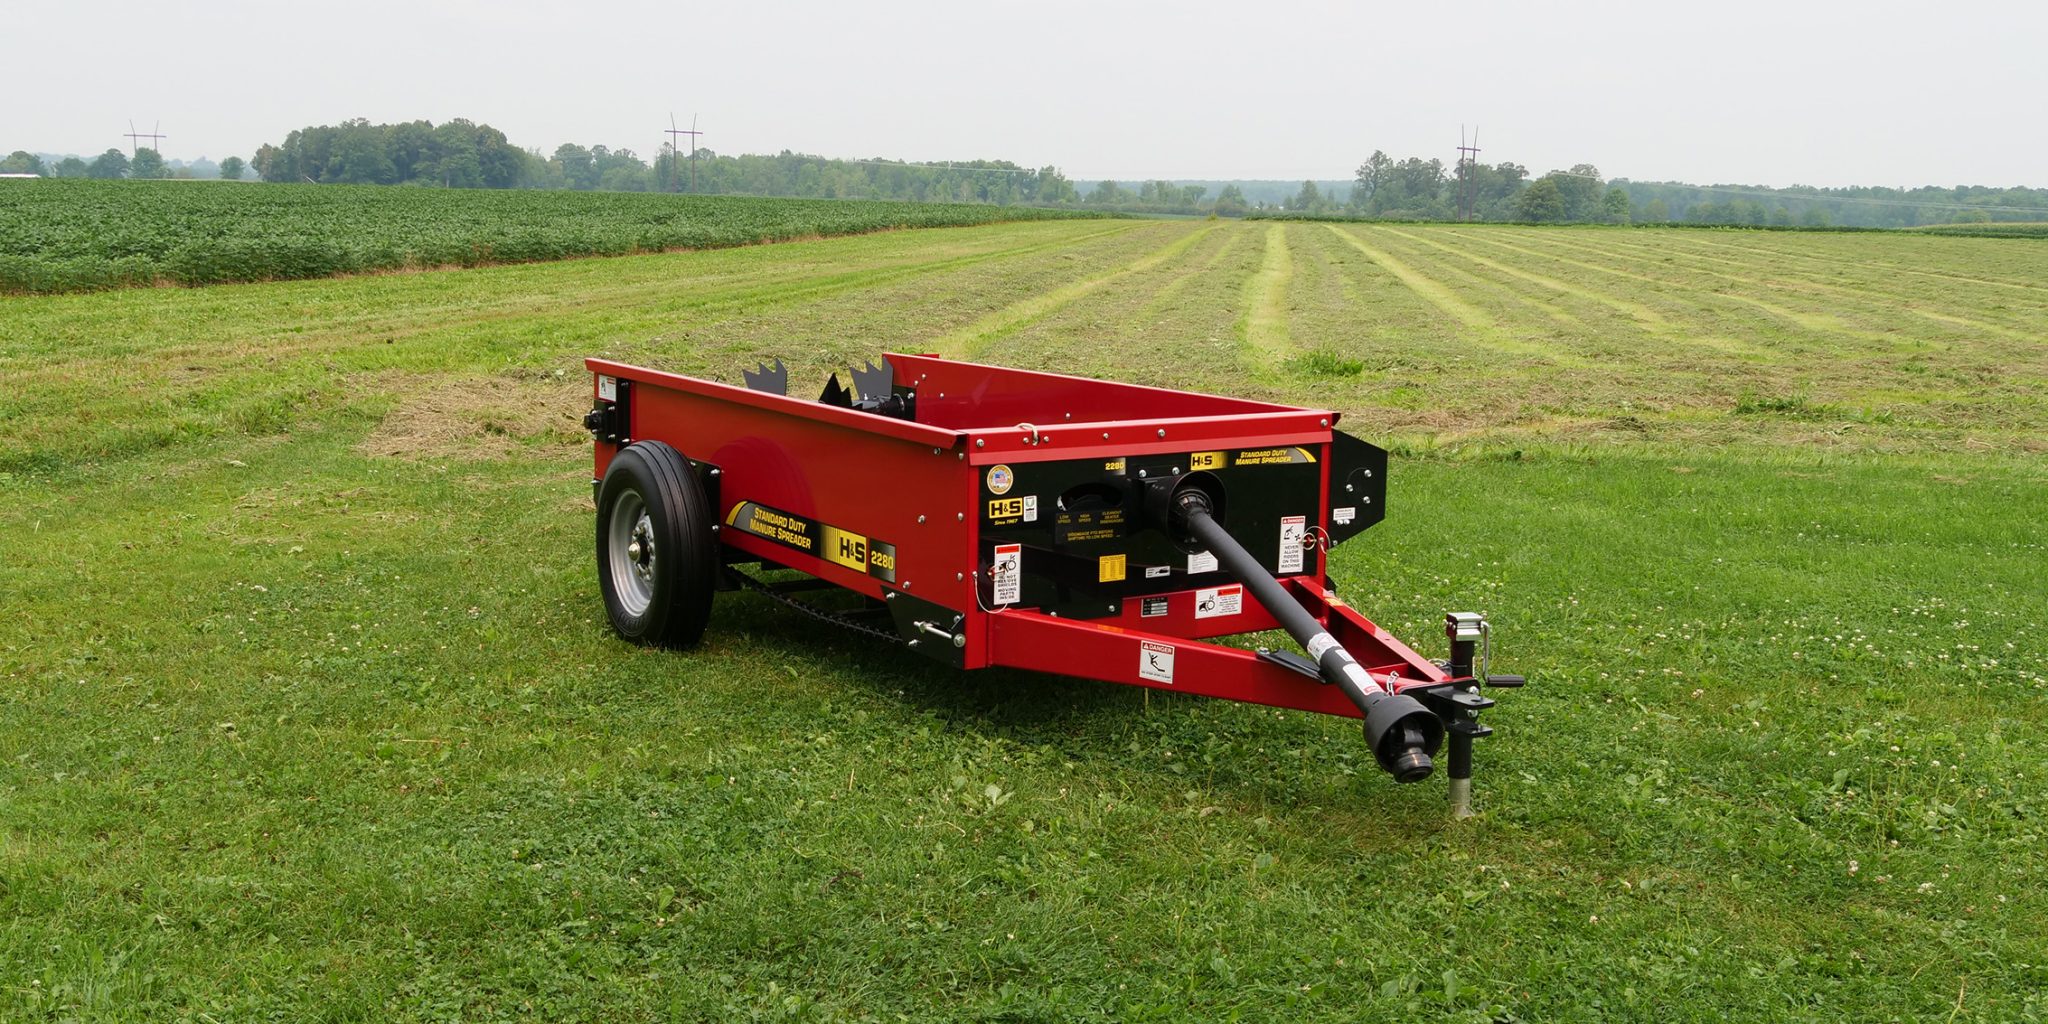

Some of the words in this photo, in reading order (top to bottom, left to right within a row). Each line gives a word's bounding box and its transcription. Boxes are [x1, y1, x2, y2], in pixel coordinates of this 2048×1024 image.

[1192, 455, 1213, 466] H&S
[1235, 457, 1261, 465] MANURE
[1261, 456, 1292, 464] SPREADER
[1241, 450, 1271, 458] STANDARD
[1272, 449, 1287, 457] DUTY
[991, 500, 1021, 516] H&S
[754, 507, 788, 528] STANDARD
[789, 517, 807, 533] DUTY
[750, 518, 777, 537] MANURE
[777, 526, 812, 549] SPREADER
[840, 537, 865, 563] H&S
[871, 551, 894, 570] 2280
[1149, 643, 1173, 654] DANGER
